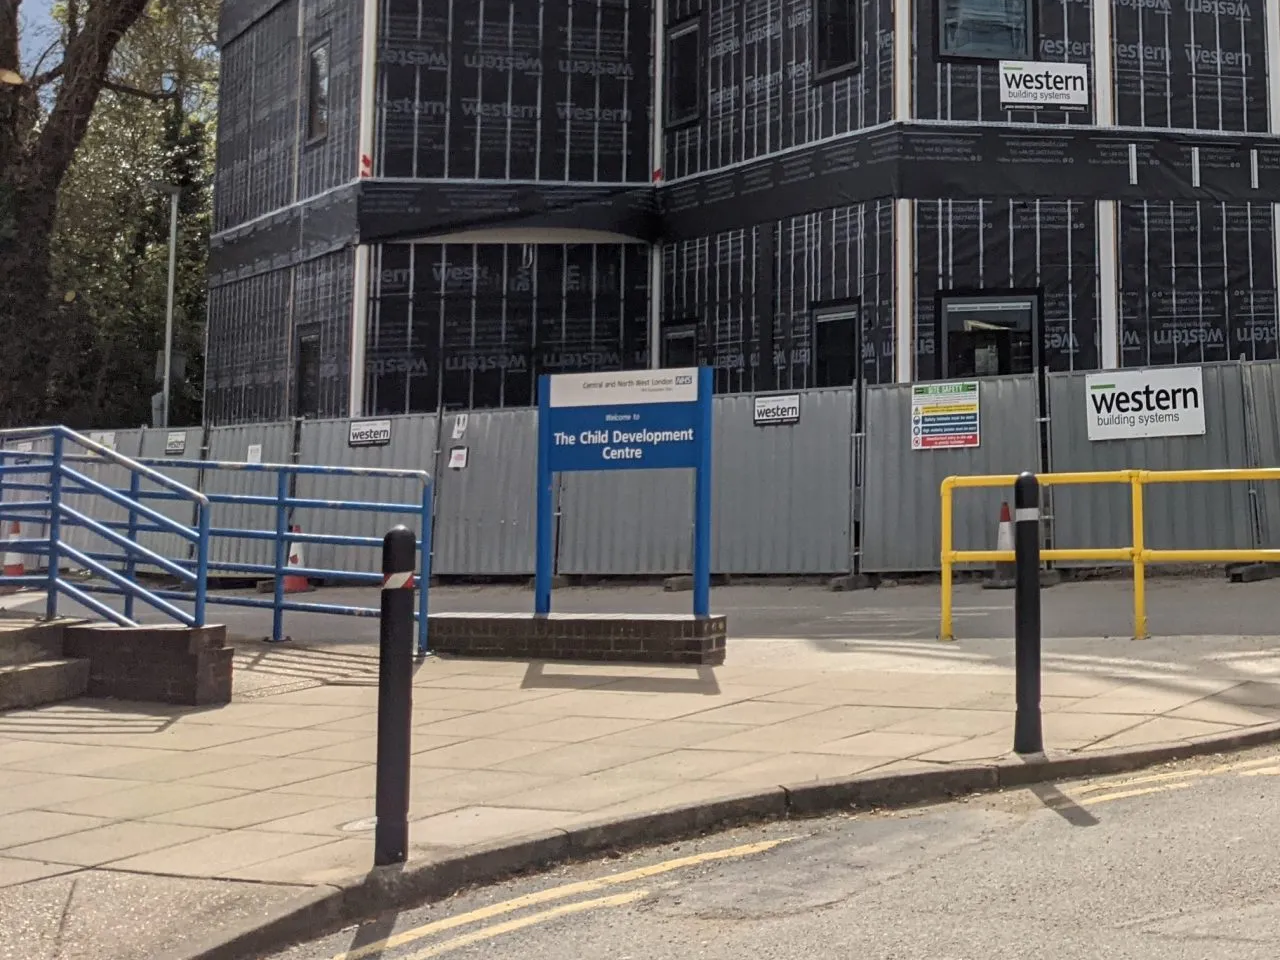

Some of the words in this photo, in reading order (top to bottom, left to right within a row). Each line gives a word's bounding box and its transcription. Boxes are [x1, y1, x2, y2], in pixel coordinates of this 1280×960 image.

[1003, 70, 1084, 91] western
[1008, 90, 1038, 100] building
[1039, 92, 1071, 100] systems
[1153, 327, 1224, 347] western
[651, 378, 673, 386] London
[675, 376, 693, 385] NHS
[941, 385, 963, 393] SAFETY
[1091, 384, 1199, 415] western
[757, 405, 798, 418] western
[1097, 414, 1136, 427] building
[1138, 412, 1180, 426] systems
[351, 428, 389, 440] western
[554, 432, 576, 445] The
[580, 430, 609, 445] Child
[613, 428, 694, 445] Development
[602, 446, 642, 459] Centre
